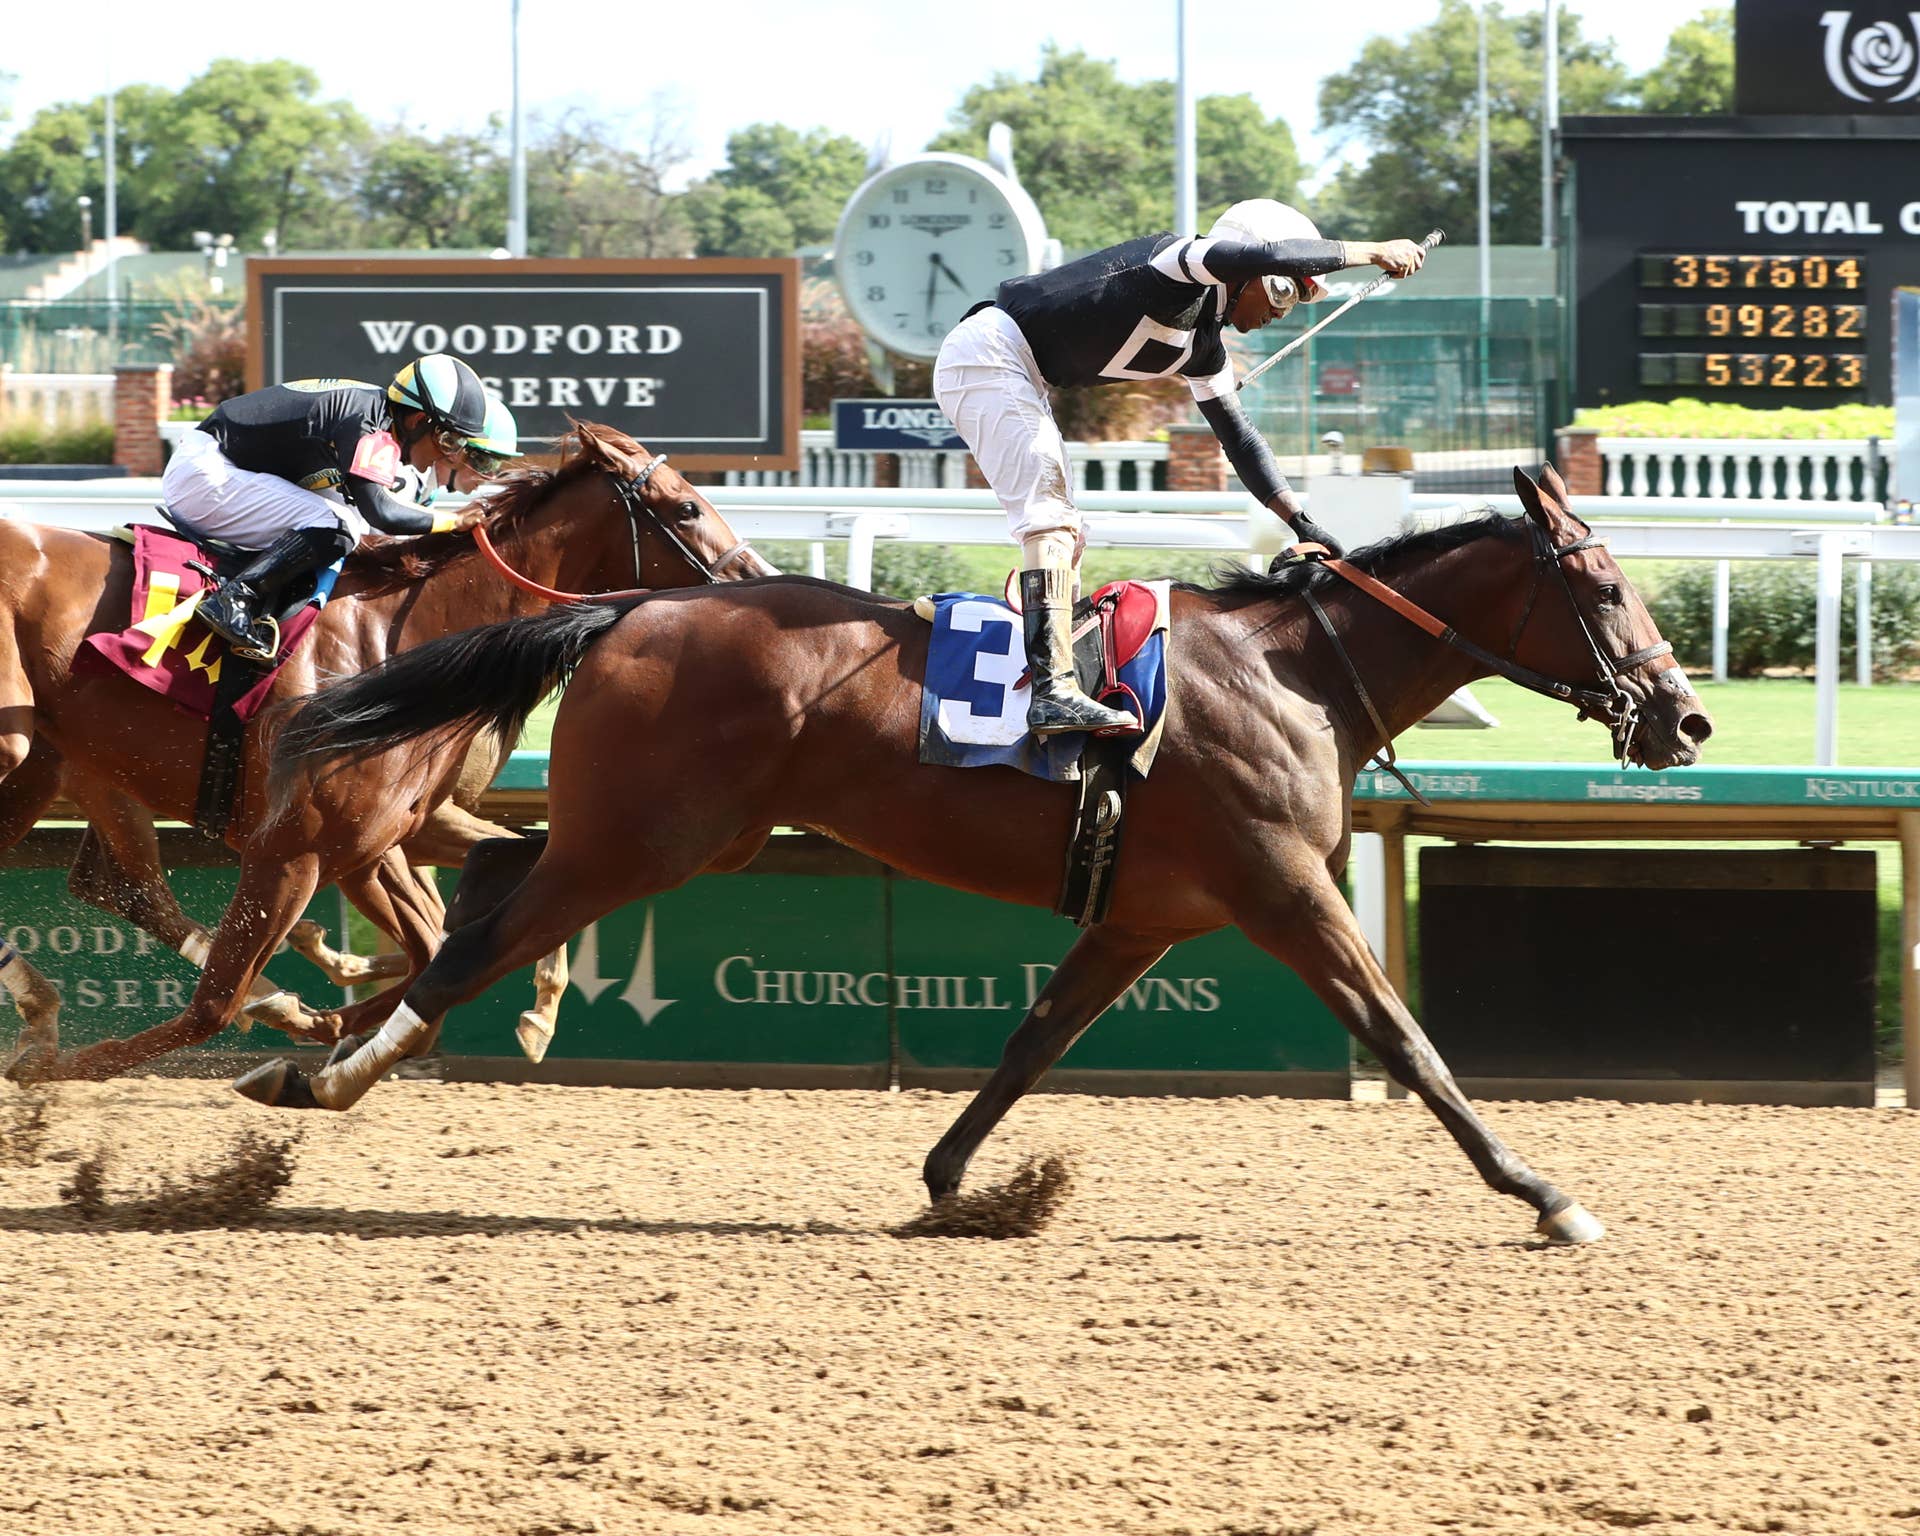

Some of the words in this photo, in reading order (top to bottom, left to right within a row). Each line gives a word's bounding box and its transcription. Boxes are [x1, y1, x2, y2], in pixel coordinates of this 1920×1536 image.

[1735, 201, 1884, 234] TOTAL
[1673, 255, 1861, 289] 357604
[1705, 304, 1862, 337] 99282
[361, 321, 683, 354] WOODFORD
[1705, 354, 1862, 387] 53223
[479, 376, 656, 407] SERVE
[359, 438, 396, 473] 14
[938, 601, 1033, 747] 3
[714, 956, 1012, 1010] CHURCHILL
[1019, 963, 1221, 1012] DWNS
